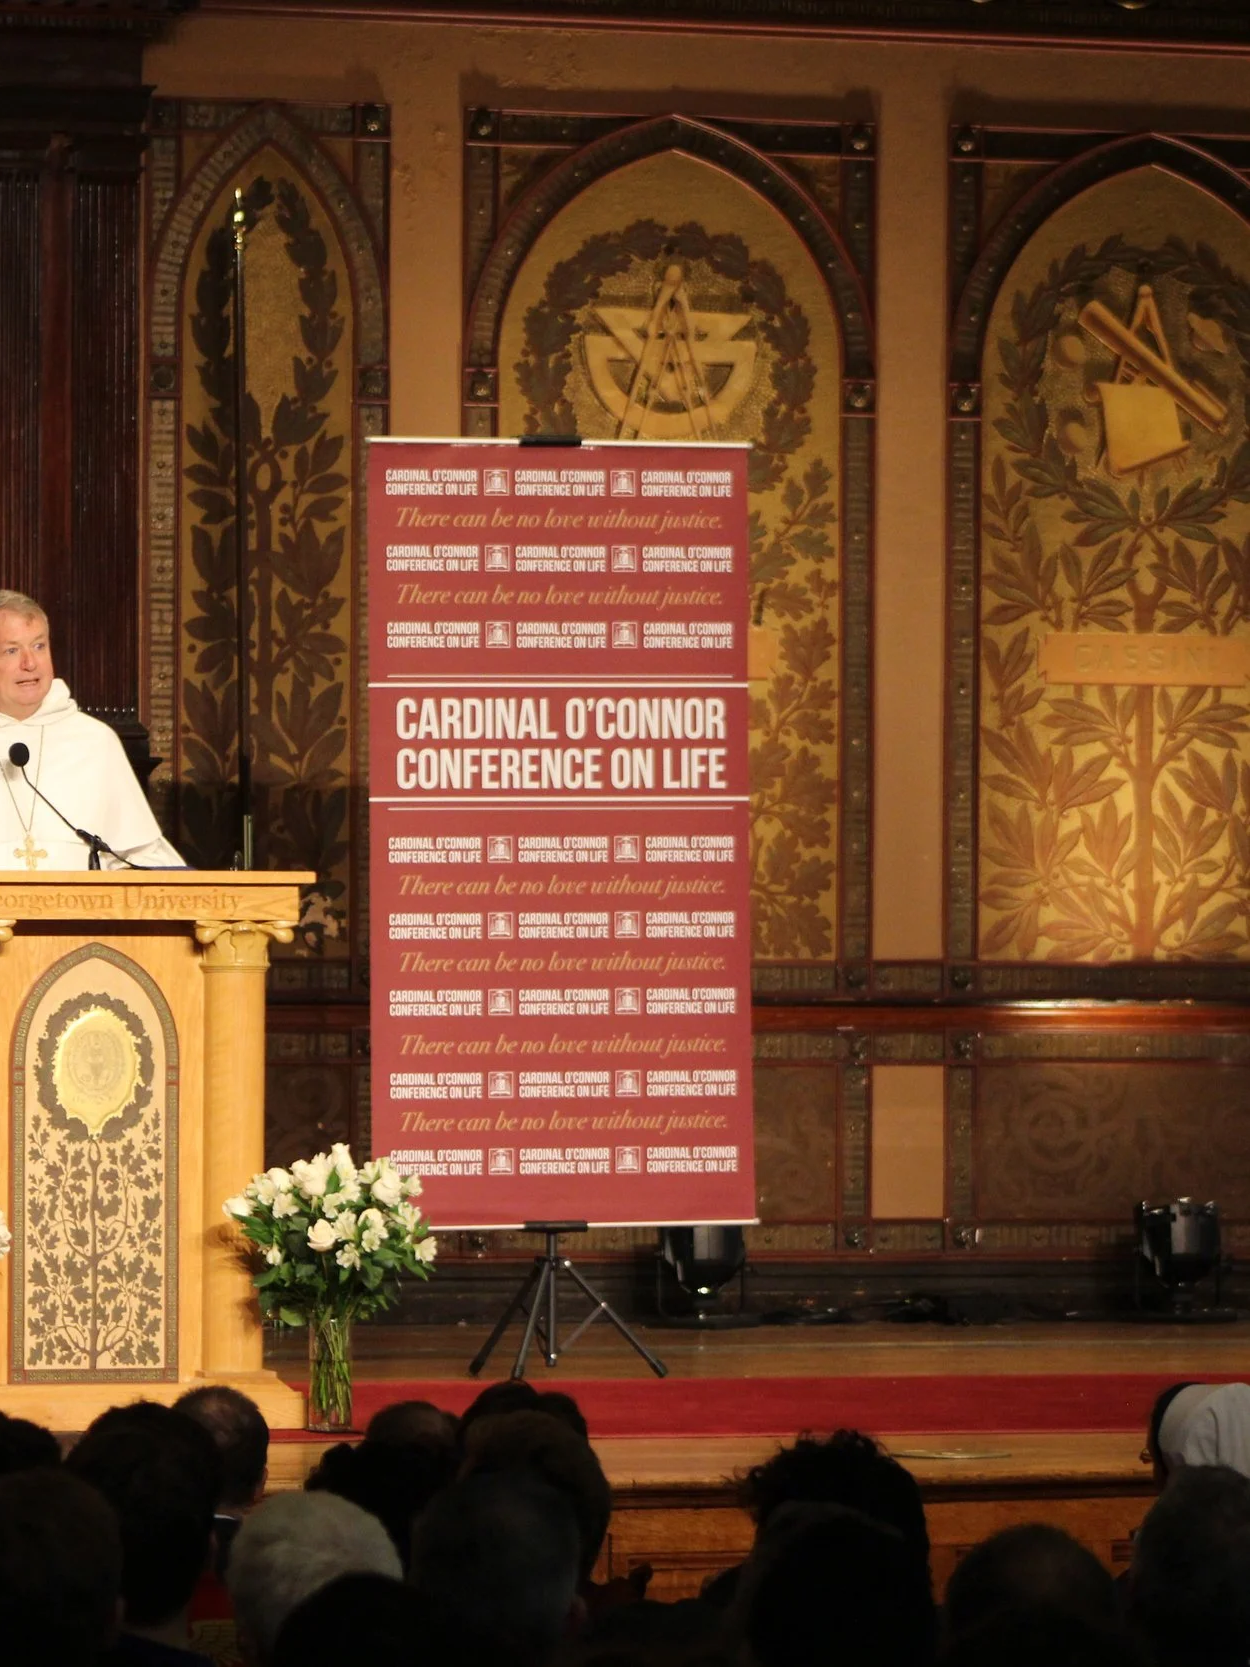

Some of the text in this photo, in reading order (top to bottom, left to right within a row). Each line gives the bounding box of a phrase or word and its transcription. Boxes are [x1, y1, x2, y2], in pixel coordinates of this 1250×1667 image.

[386, 469, 478, 481] CARDINAL O'CONNOR
[514, 470, 606, 482] CARDINAL O'CONNOR
[641, 471, 731, 482] CARDINAL O'CONNOR
[386, 483, 478, 495] CONFERENCE ON LIFE
[514, 484, 606, 495] CONFERENCE ON LIFE
[641, 485, 731, 496] CONFERENCE ON LIFE
[395, 506, 723, 534] There can be no love without justice.
[396, 697, 725, 740] CARDINAL O'CONNOR
[396, 747, 727, 789] CONFERENCE ON LIFE
[398, 873, 726, 900] There can be no love without justice.
[123, 885, 244, 917] University
[389, 913, 482, 925] CARDINAL O'CONNOR
[518, 912, 609, 924] CARDINAL O'CONNOR
[645, 911, 735, 924] CARDINAL O'CONNOR
[389, 926, 482, 939] CONFERENCE ON LIFE
[518, 926, 610, 938] CONFERENCE ON LIFE
[645, 925, 736, 937] CONFERENCE ON LIFE
[400, 1110, 729, 1136] There can be no love without justice.
